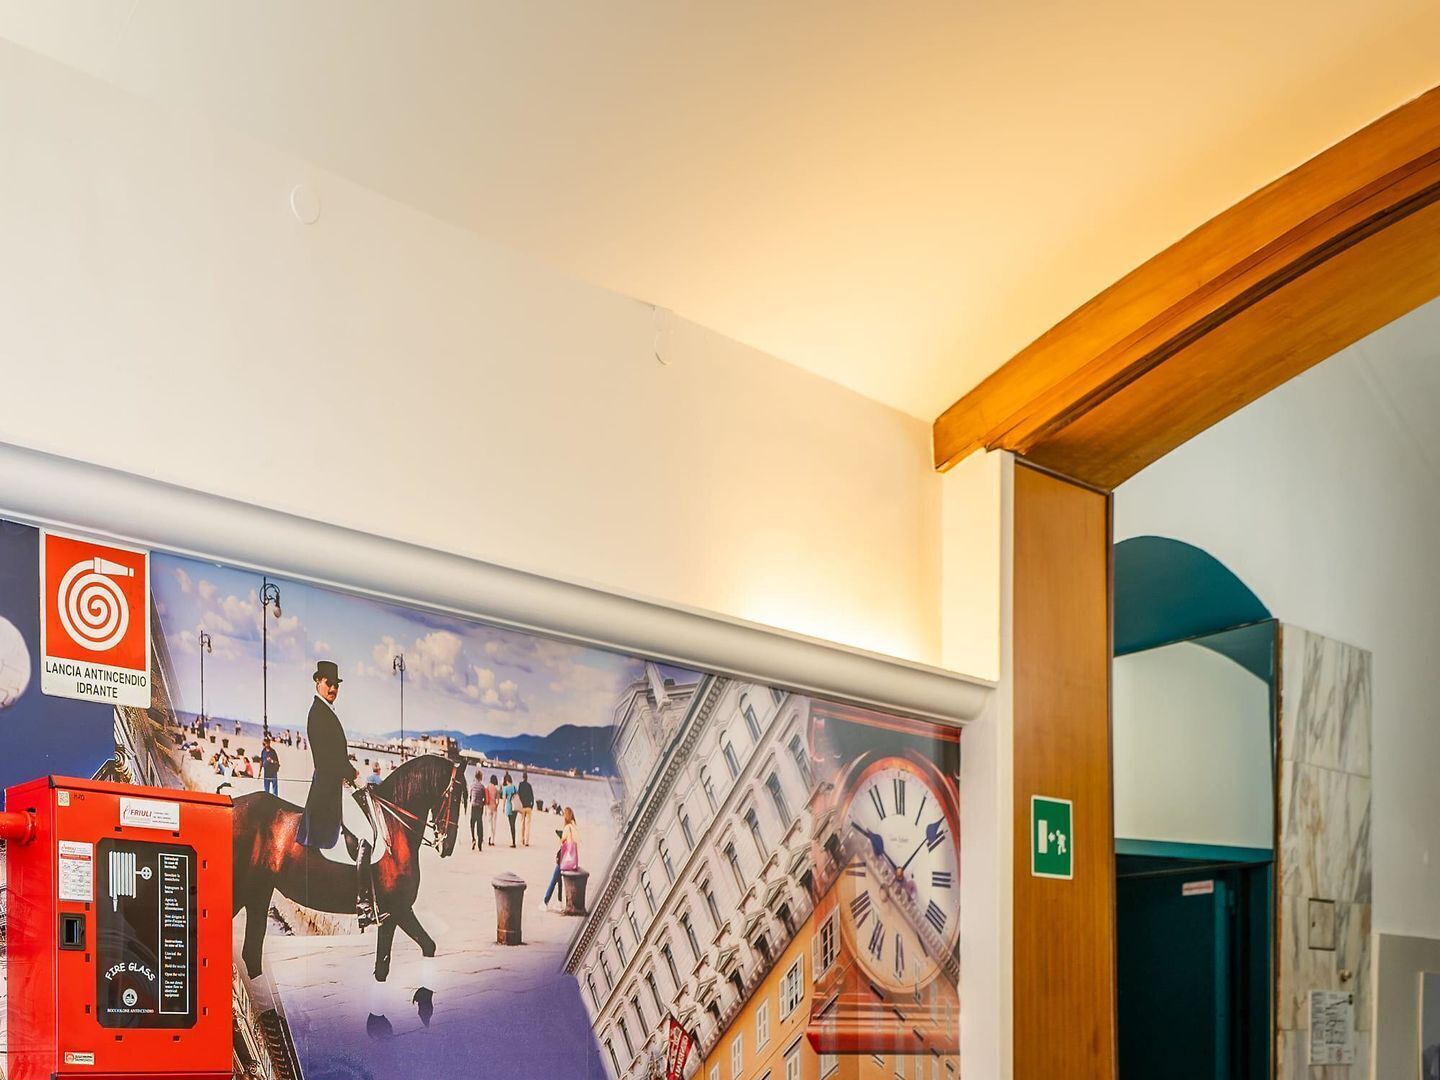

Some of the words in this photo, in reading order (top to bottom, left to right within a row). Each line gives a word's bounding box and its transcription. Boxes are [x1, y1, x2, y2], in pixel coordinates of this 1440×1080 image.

[45, 661, 82, 678] LANCIA
[84, 667, 147, 688] ANTINCENDIO
[76, 681, 118, 698] IDRANTE
[130, 809, 153, 818] FRIULI
[105, 962, 127, 981] FIRE
[128, 962, 156, 981] GLASS
